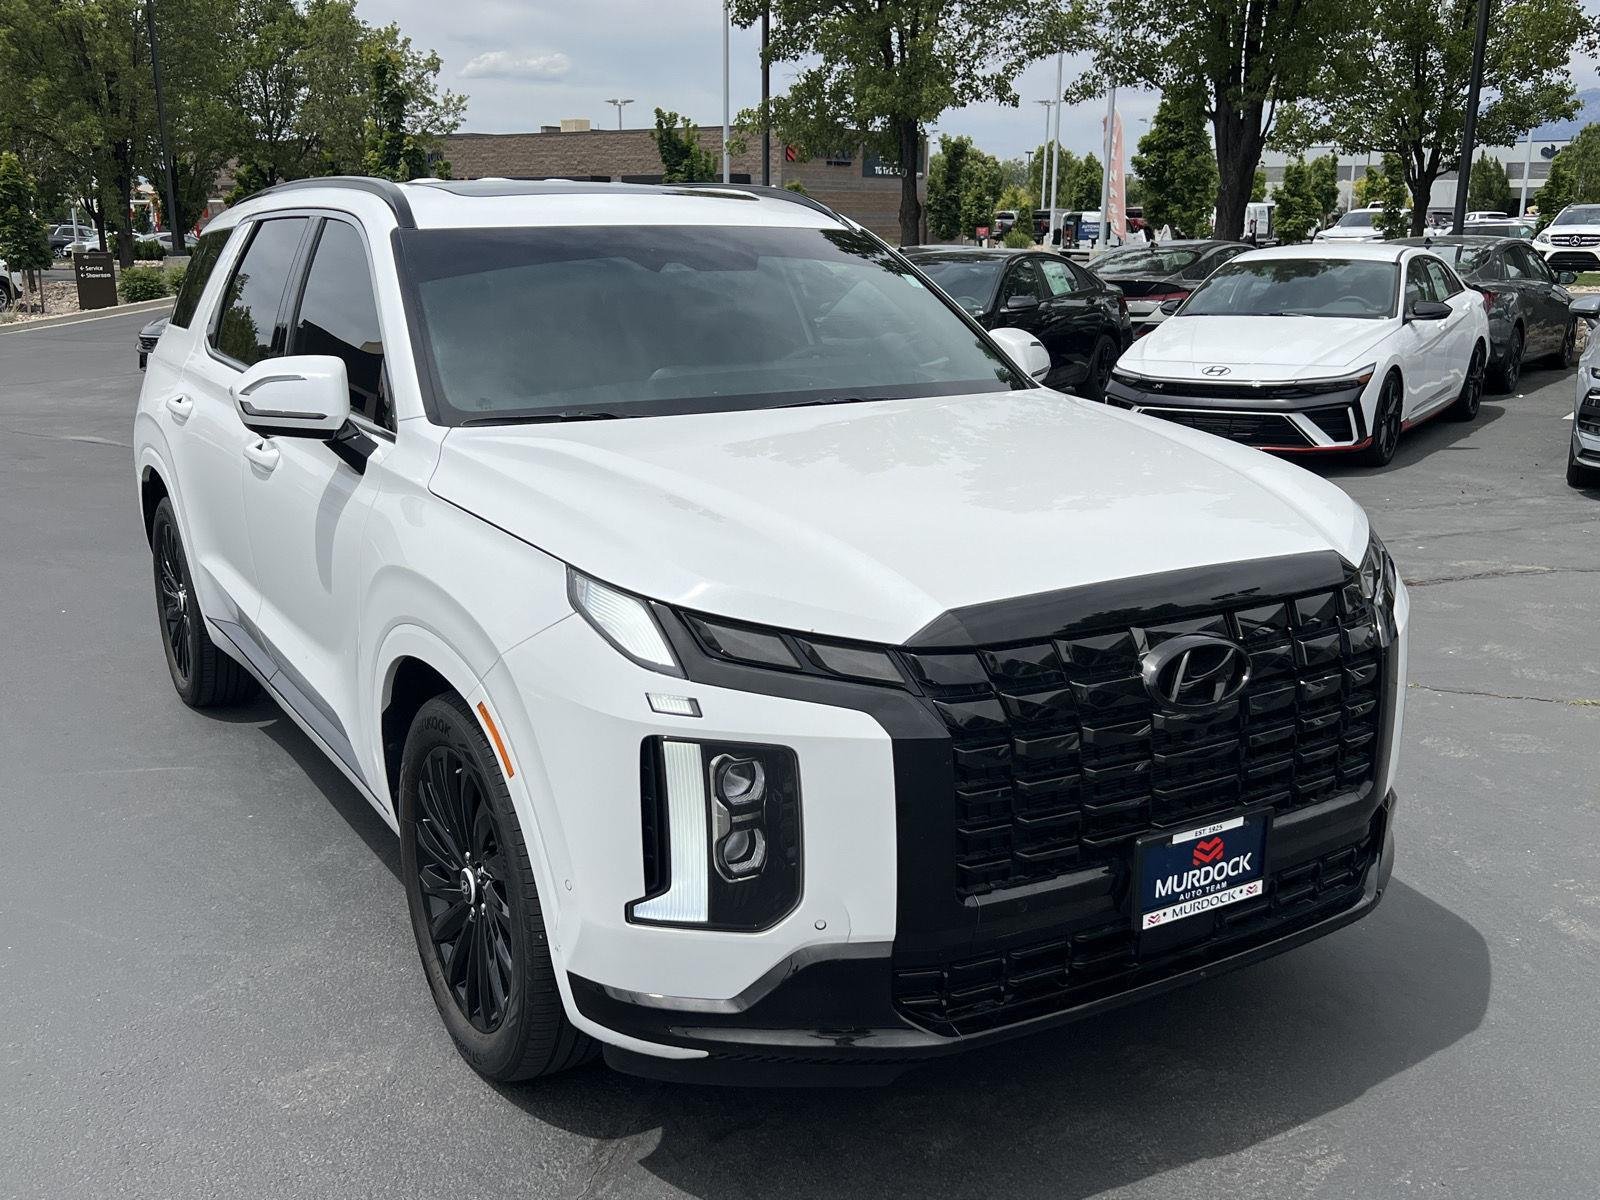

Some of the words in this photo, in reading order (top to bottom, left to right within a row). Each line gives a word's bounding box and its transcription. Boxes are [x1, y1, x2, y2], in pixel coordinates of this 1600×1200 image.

[1155, 852, 1252, 898] MURDOCK
[1172, 890, 1237, 918] MURDOCK
[1179, 889, 1202, 901] AUTO
[1205, 880, 1228, 893] TEAM
